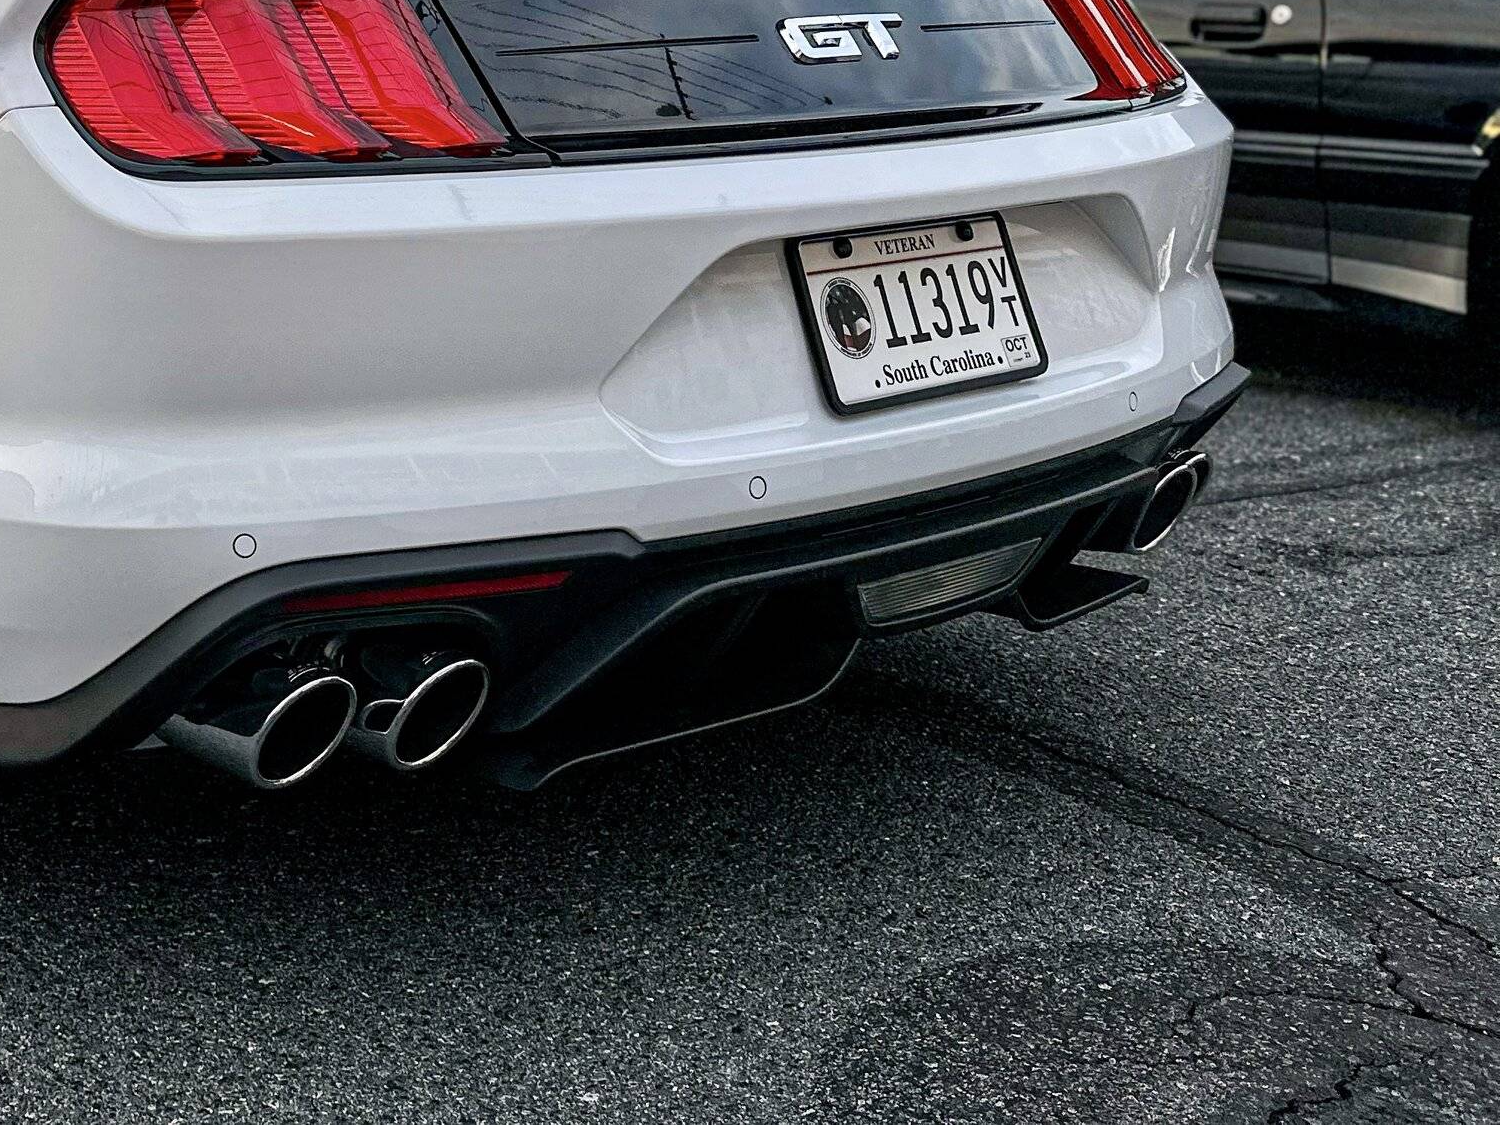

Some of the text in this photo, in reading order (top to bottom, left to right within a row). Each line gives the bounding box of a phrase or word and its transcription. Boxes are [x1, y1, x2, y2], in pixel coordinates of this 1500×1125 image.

[776, 13, 902, 65] GT
[874, 234, 936, 255] VETERAN
[873, 260, 995, 348] 11319
[1005, 337, 1027, 352] OCT
[882, 349, 995, 386] South Carolina
